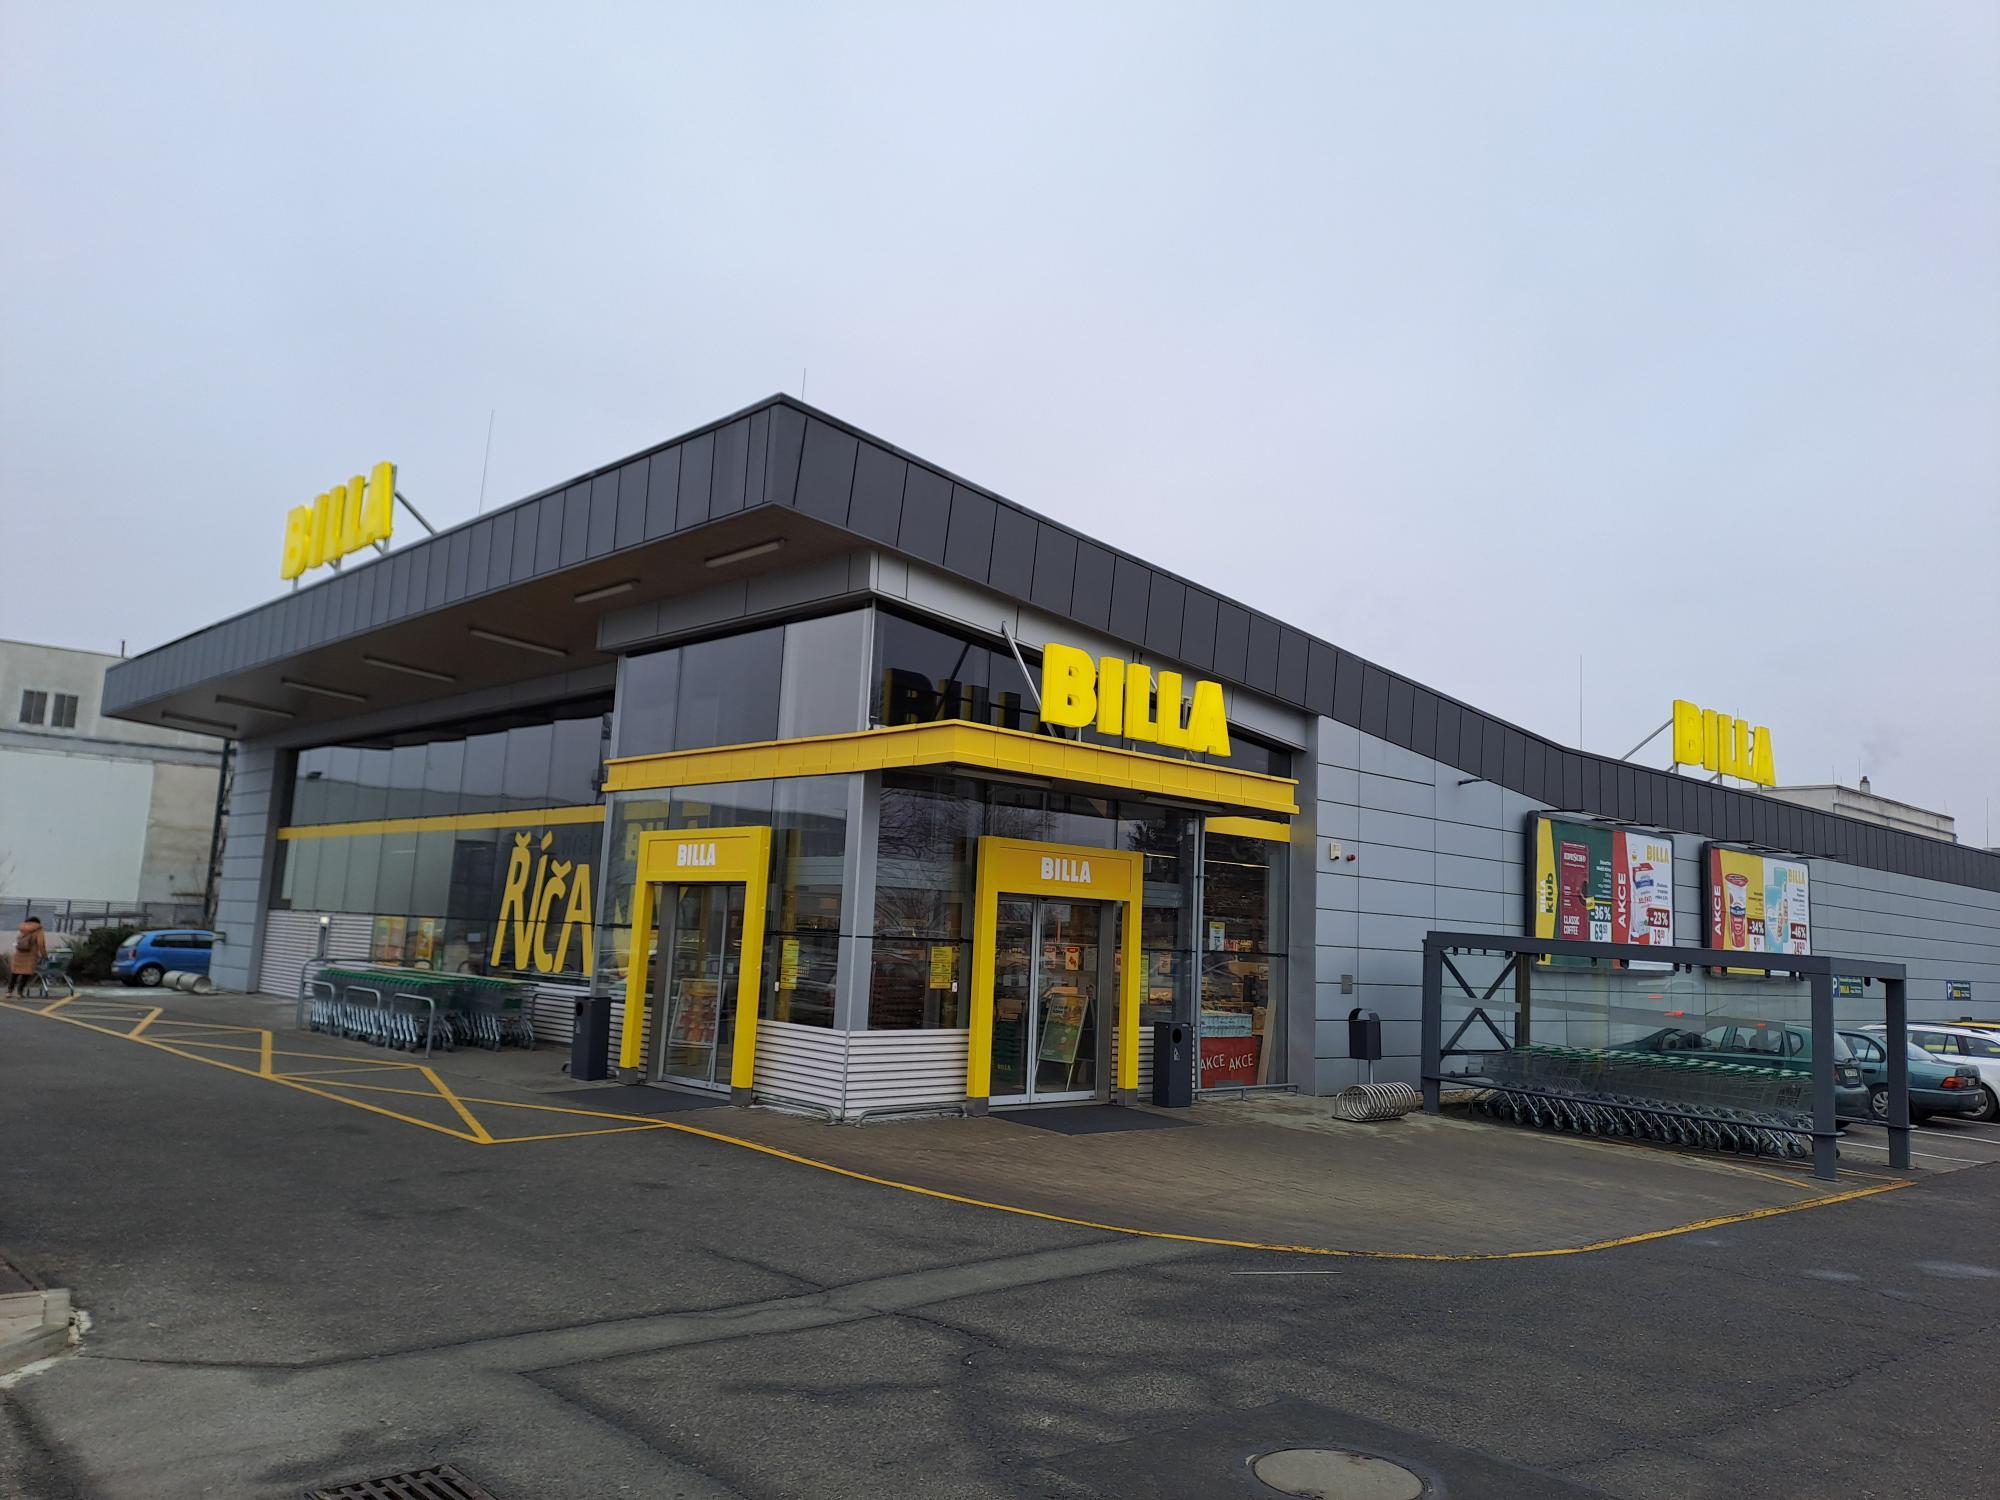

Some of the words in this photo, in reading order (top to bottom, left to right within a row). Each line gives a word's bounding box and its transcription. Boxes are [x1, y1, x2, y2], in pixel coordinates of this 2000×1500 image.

[281, 461, 395, 580] BILLA
[1041, 643, 1231, 757] BILLA
[1673, 699, 1777, 787] BILLA
[675, 842, 716, 867] BILLA
[1647, 845, 1669, 864] BILLA
[1040, 856, 1092, 885] BILLA
[1788, 868, 1806, 886] BILLA
[1546, 873, 1554, 913] klub
[1618, 873, 1626, 928] AKCE
[1590, 905, 1611, 922] -36%
[1649, 911, 1668, 926] -23%
[1713, 885, 1721, 935] AKCE
[1833, 977, 1838, 994] P
[1947, 982, 1952, 998] P
[1200, 1053, 1226, 1071] AKCE
[1228, 1052, 1254, 1071] AKCE
